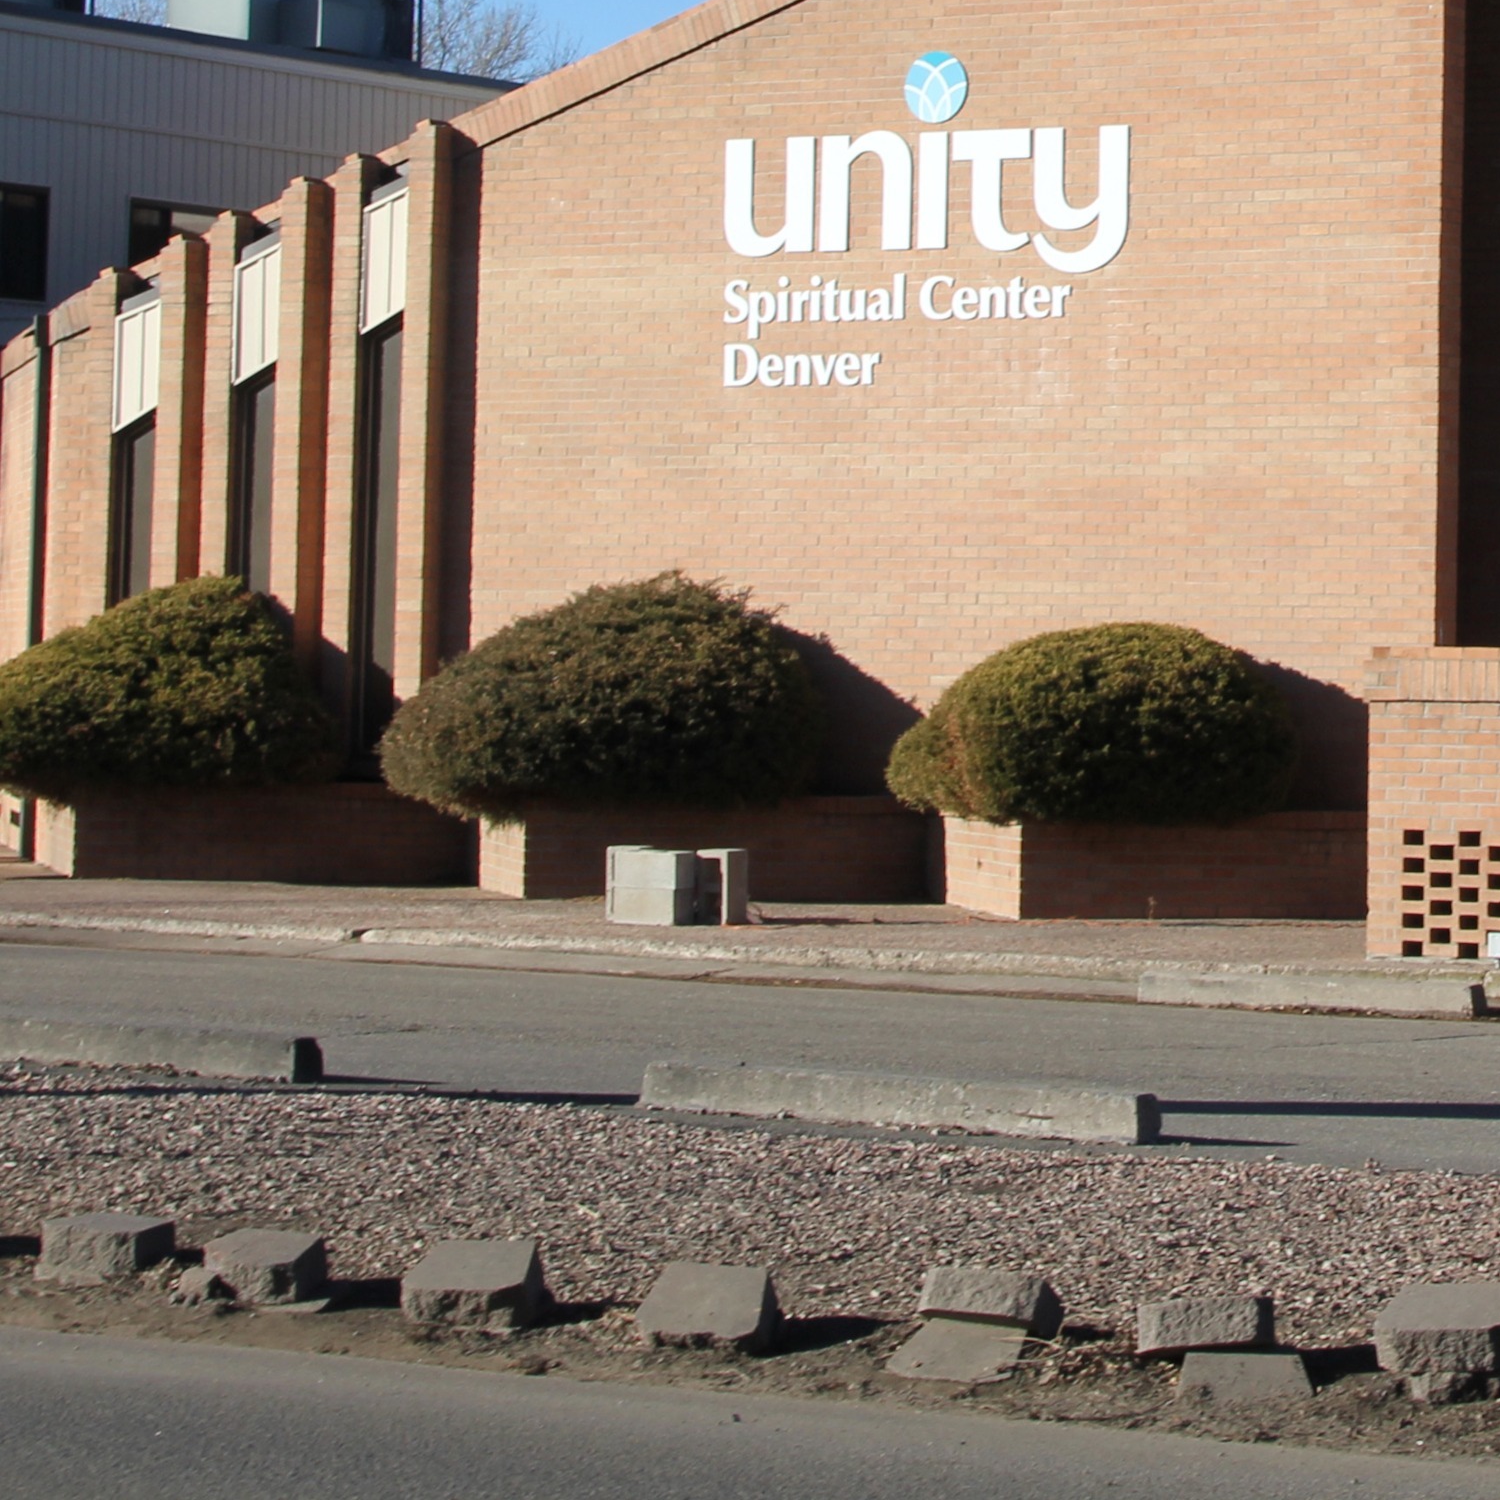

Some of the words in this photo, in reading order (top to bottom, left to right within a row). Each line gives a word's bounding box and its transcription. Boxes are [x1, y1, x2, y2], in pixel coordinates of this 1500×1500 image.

[724, 125, 1131, 274] unity
[723, 273, 907, 339] Spiritual
[919, 276, 1072, 320] Center
[723, 344, 881, 387] Denver
